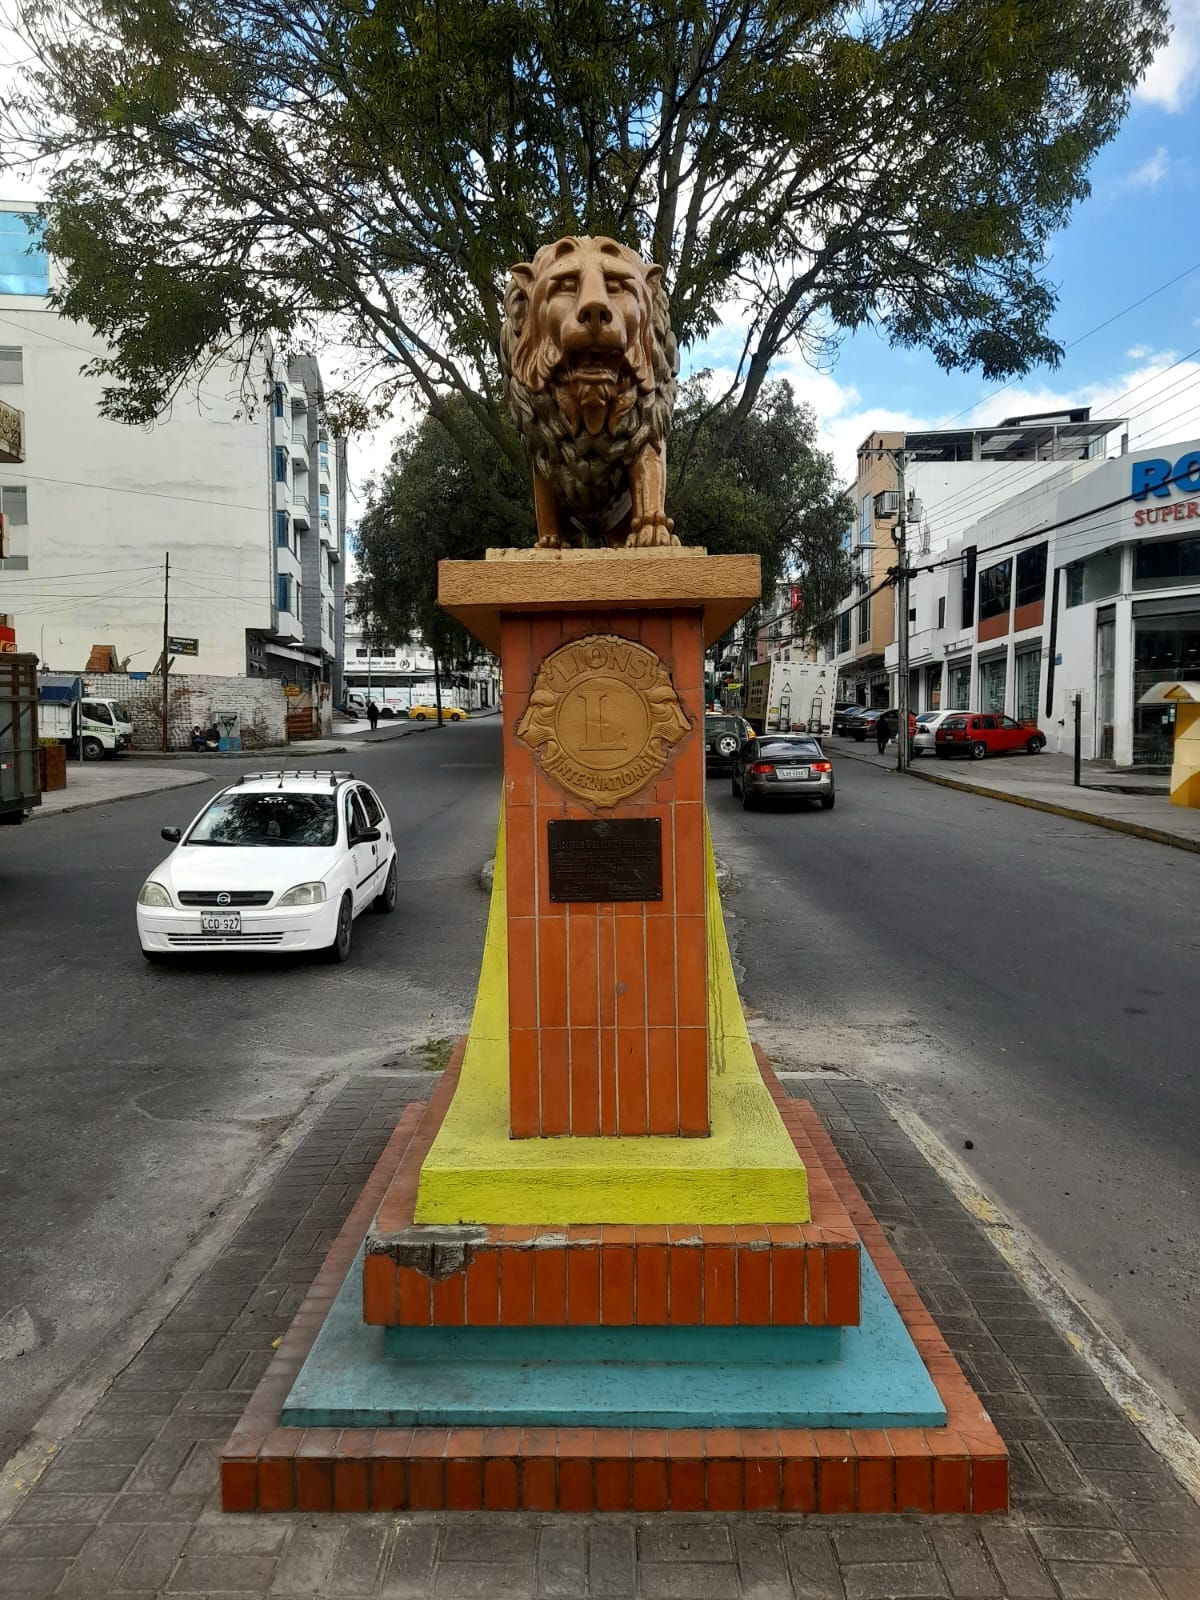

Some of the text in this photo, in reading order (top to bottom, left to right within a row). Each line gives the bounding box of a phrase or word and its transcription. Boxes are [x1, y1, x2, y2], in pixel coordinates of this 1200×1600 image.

[1134, 502, 1200, 526] SUPER
[552, 646, 650, 682] LIONS
[577, 690, 628, 751] L
[554, 755, 658, 791] INTERNATIONAL
